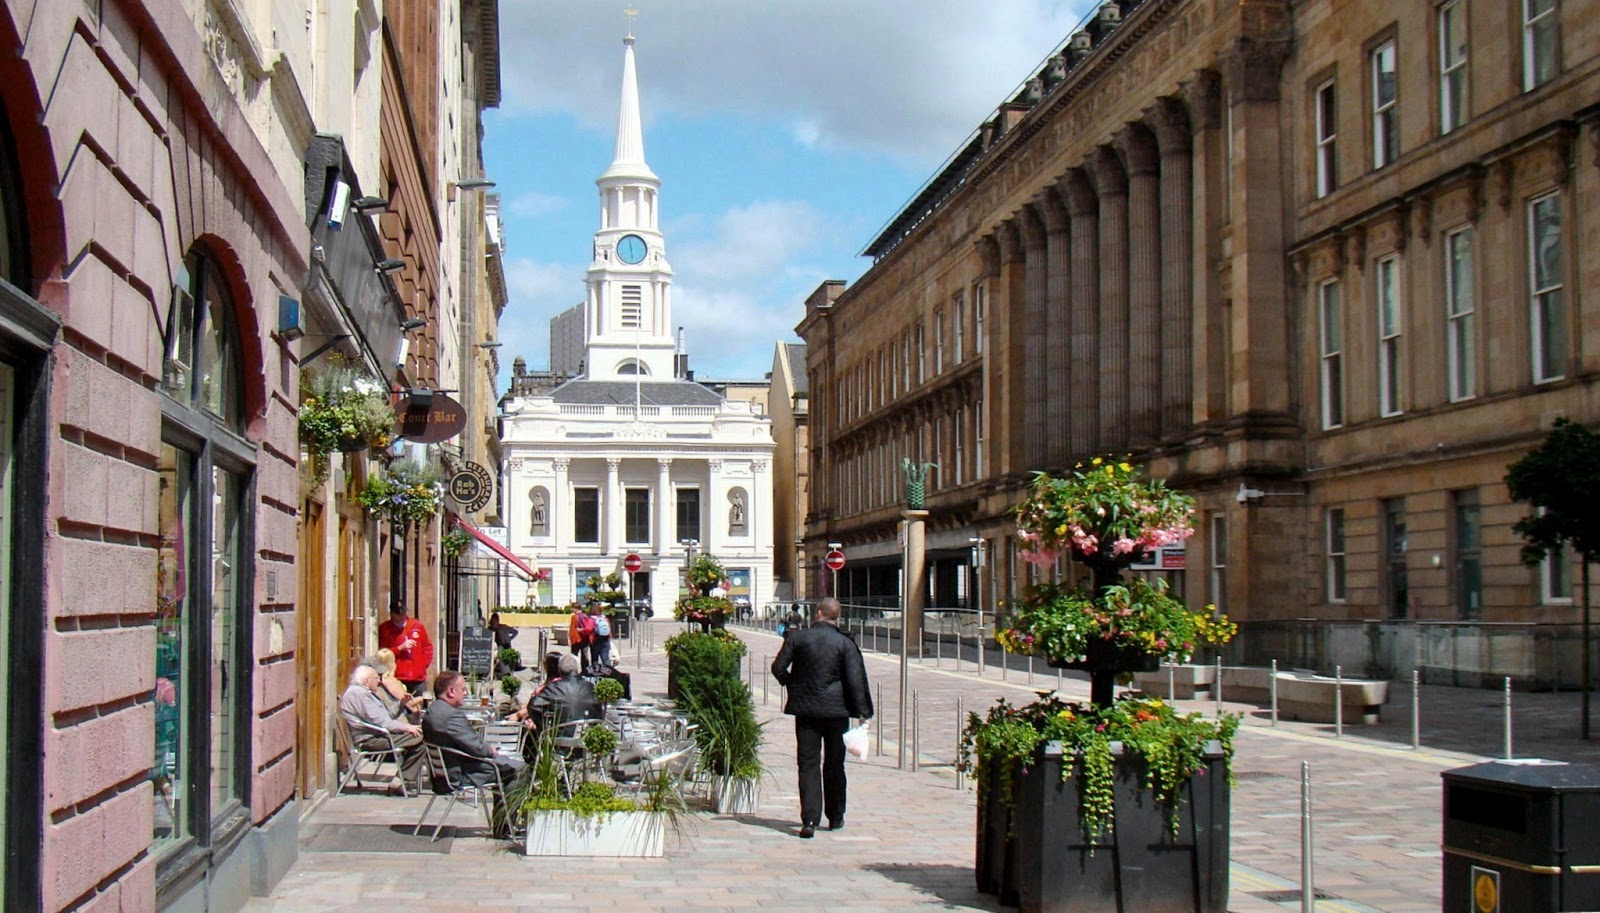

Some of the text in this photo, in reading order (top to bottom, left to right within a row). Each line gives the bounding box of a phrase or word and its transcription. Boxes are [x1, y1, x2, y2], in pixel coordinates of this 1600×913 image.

[399, 410, 457, 423] Court Bar
[456, 480, 475, 488] Rab
[467, 462, 491, 506] RESTAURANT
[456, 487, 476, 495] Ha's
[488, 527, 502, 535] Let
